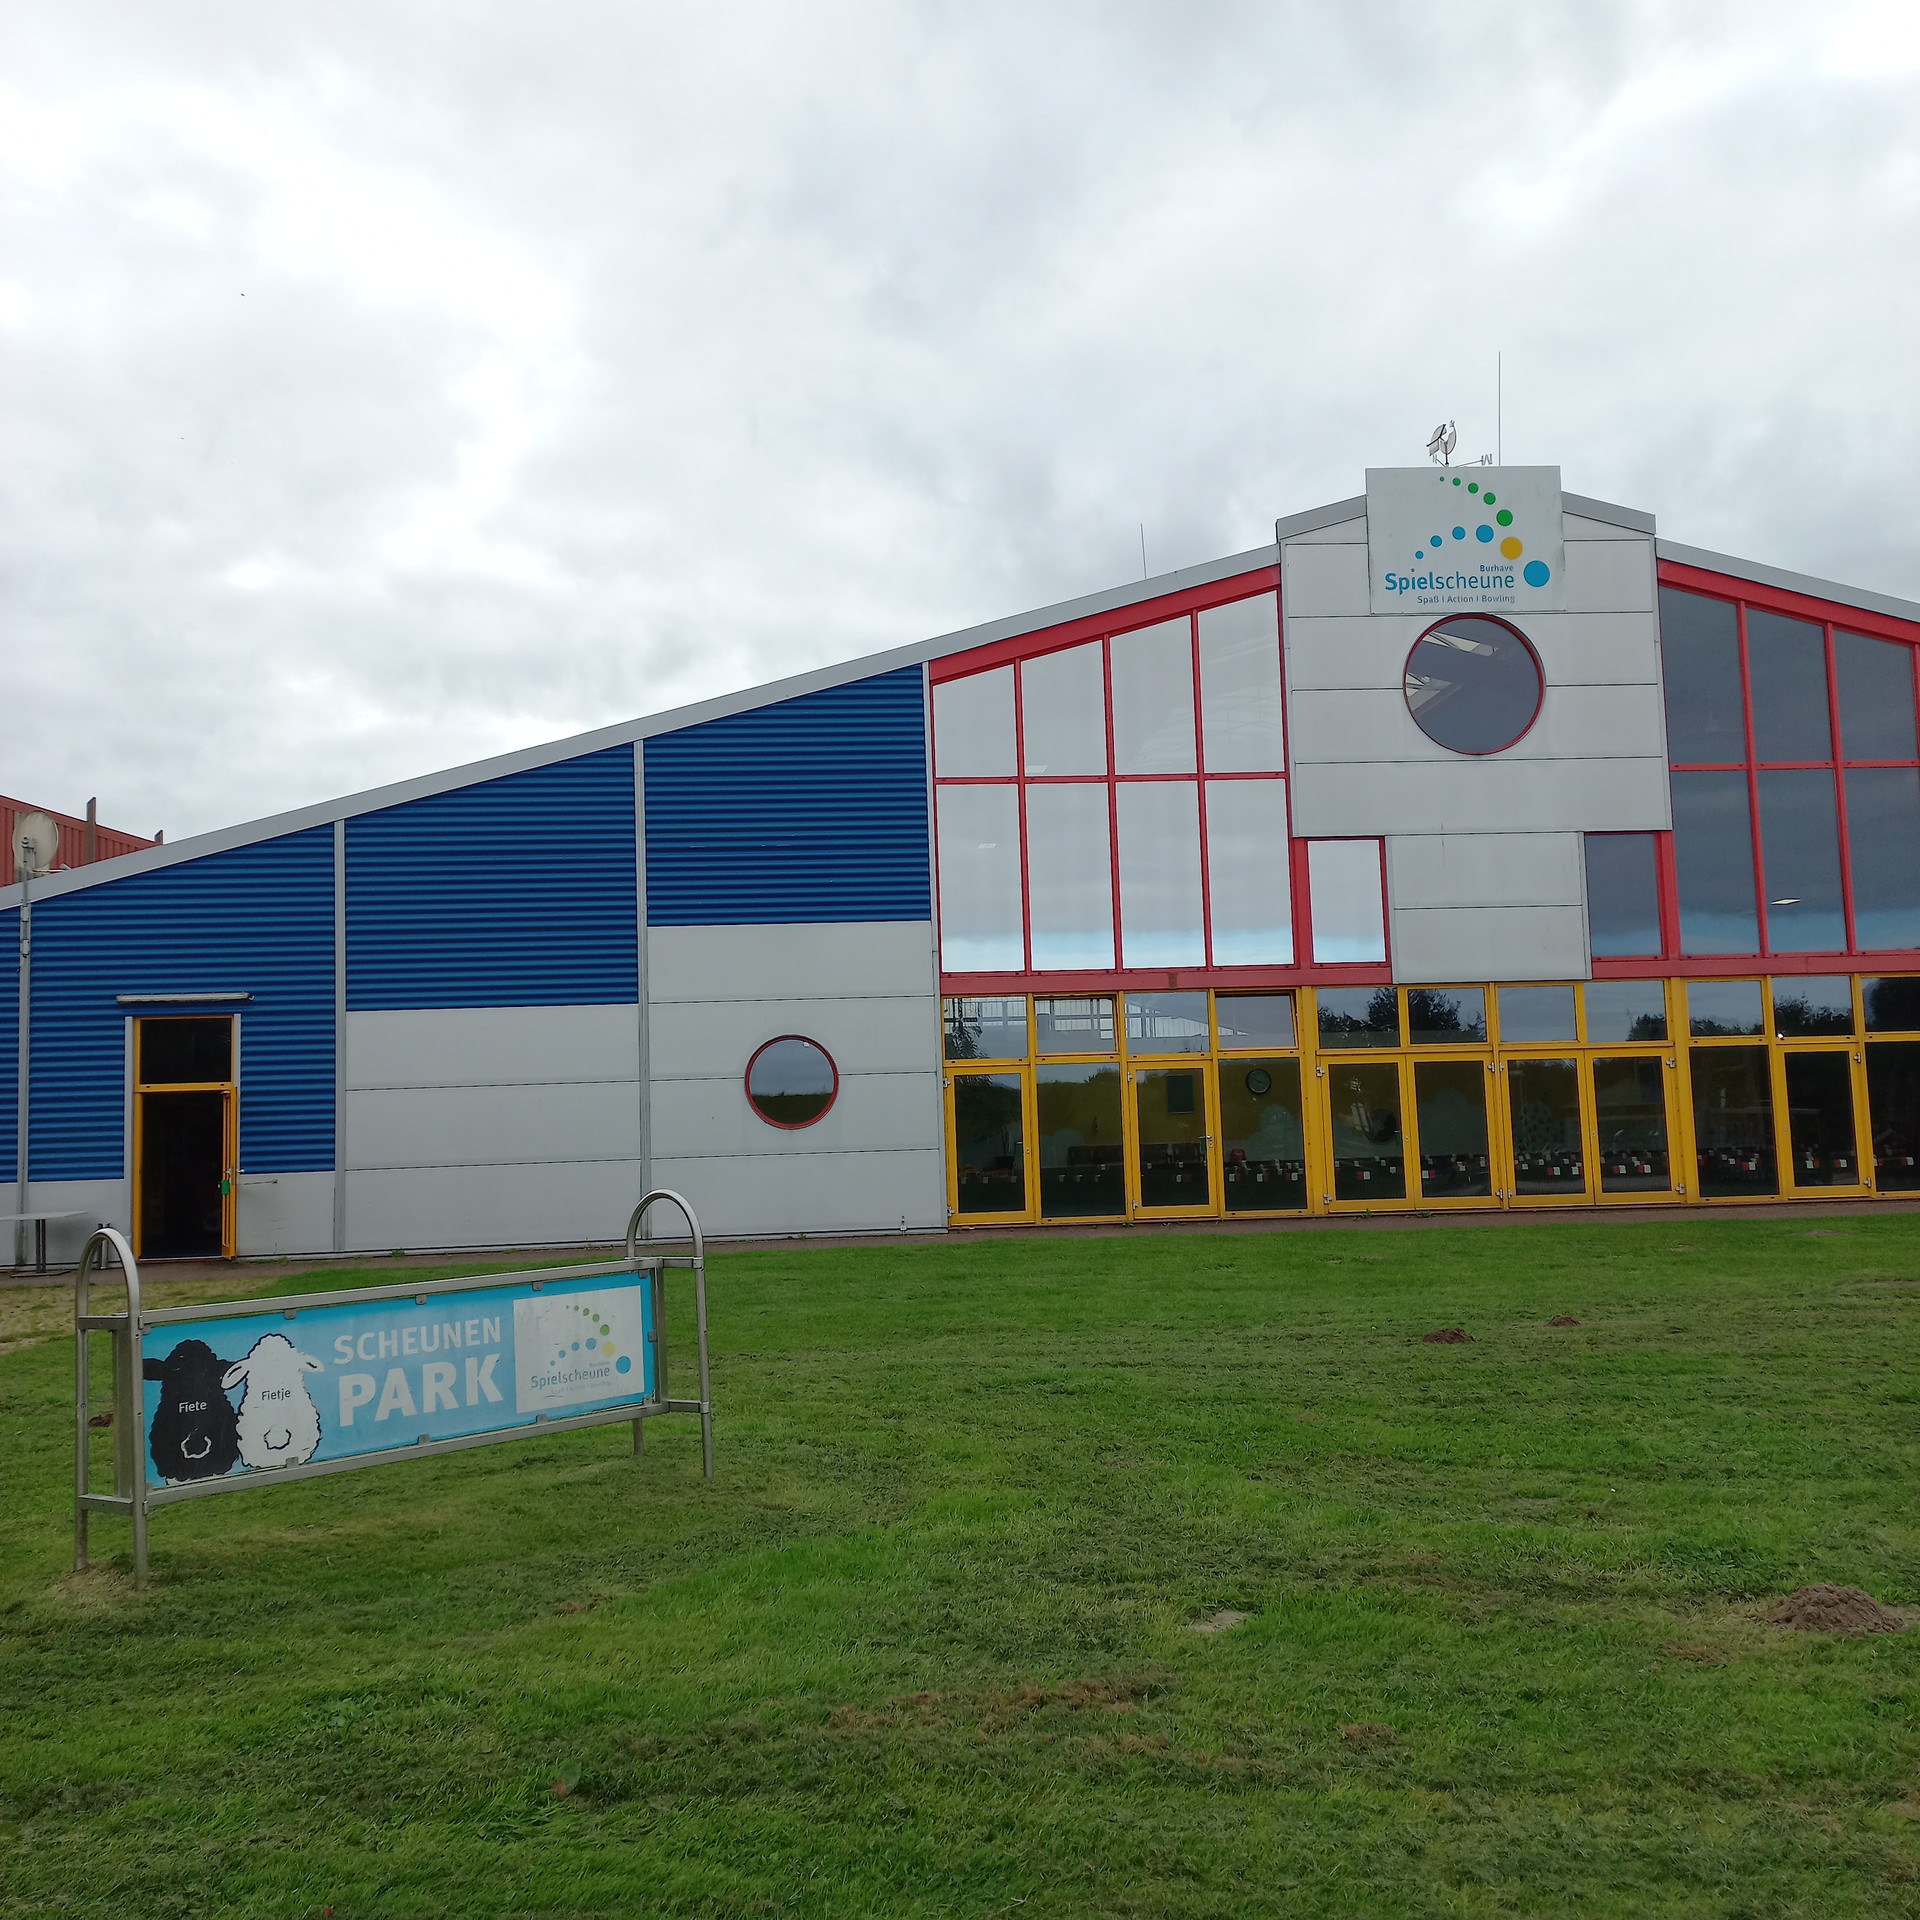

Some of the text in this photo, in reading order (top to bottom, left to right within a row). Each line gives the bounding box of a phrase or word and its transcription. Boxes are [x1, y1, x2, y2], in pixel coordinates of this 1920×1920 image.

[1480, 564, 1514, 572] Burhave
[1385, 568, 1515, 595] Spielscheune
[1417, 595, 1439, 605] Spaß
[1447, 594, 1474, 603] Action
[1481, 594, 1516, 604] Bowling
[333, 1316, 501, 1365] SCHEUNEN
[530, 1367, 611, 1390] Spielscheune
[261, 1388, 291, 1401] Fietje
[339, 1353, 504, 1427] PARK
[178, 1400, 207, 1413] Fiete
